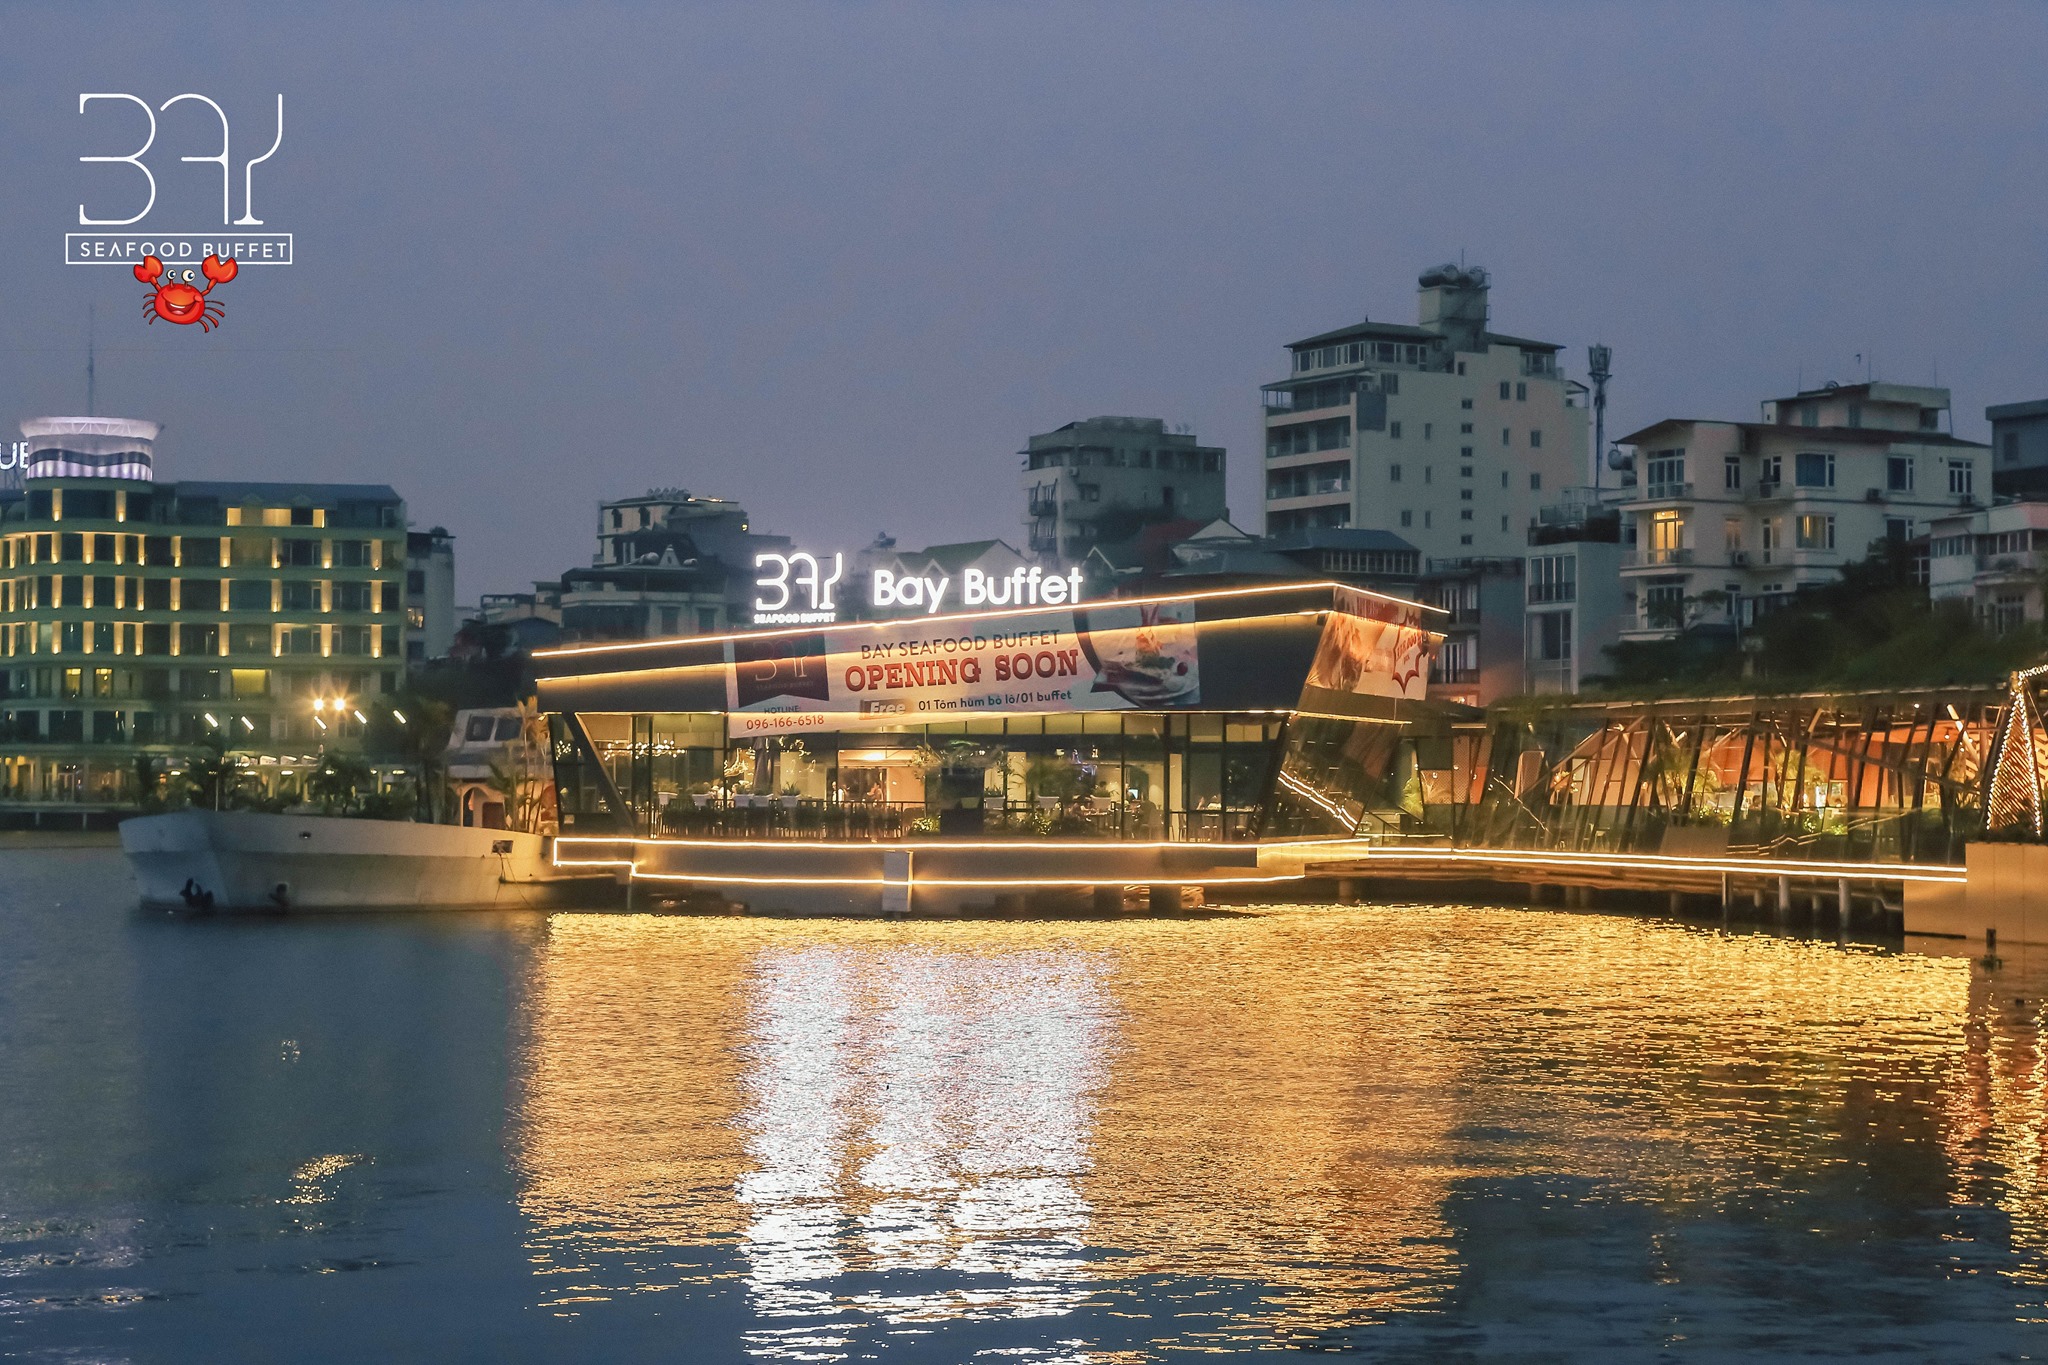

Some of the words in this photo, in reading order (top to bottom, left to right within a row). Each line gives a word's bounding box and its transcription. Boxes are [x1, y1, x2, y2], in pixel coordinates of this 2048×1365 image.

[873, 569, 950, 614] Bay
[964, 566, 1084, 605] Buffet
[860, 642, 895, 660] BAY
[898, 635, 988, 657] SEAFOOD
[993, 629, 1060, 649] BUFFET
[845, 657, 982, 692] OPENING
[994, 649, 1079, 682] SOON
[869, 701, 906, 717] Free
[918, 700, 931, 711] 01
[1036, 690, 1072, 702] buffet
[746, 714, 825, 730] 096-166-6518
